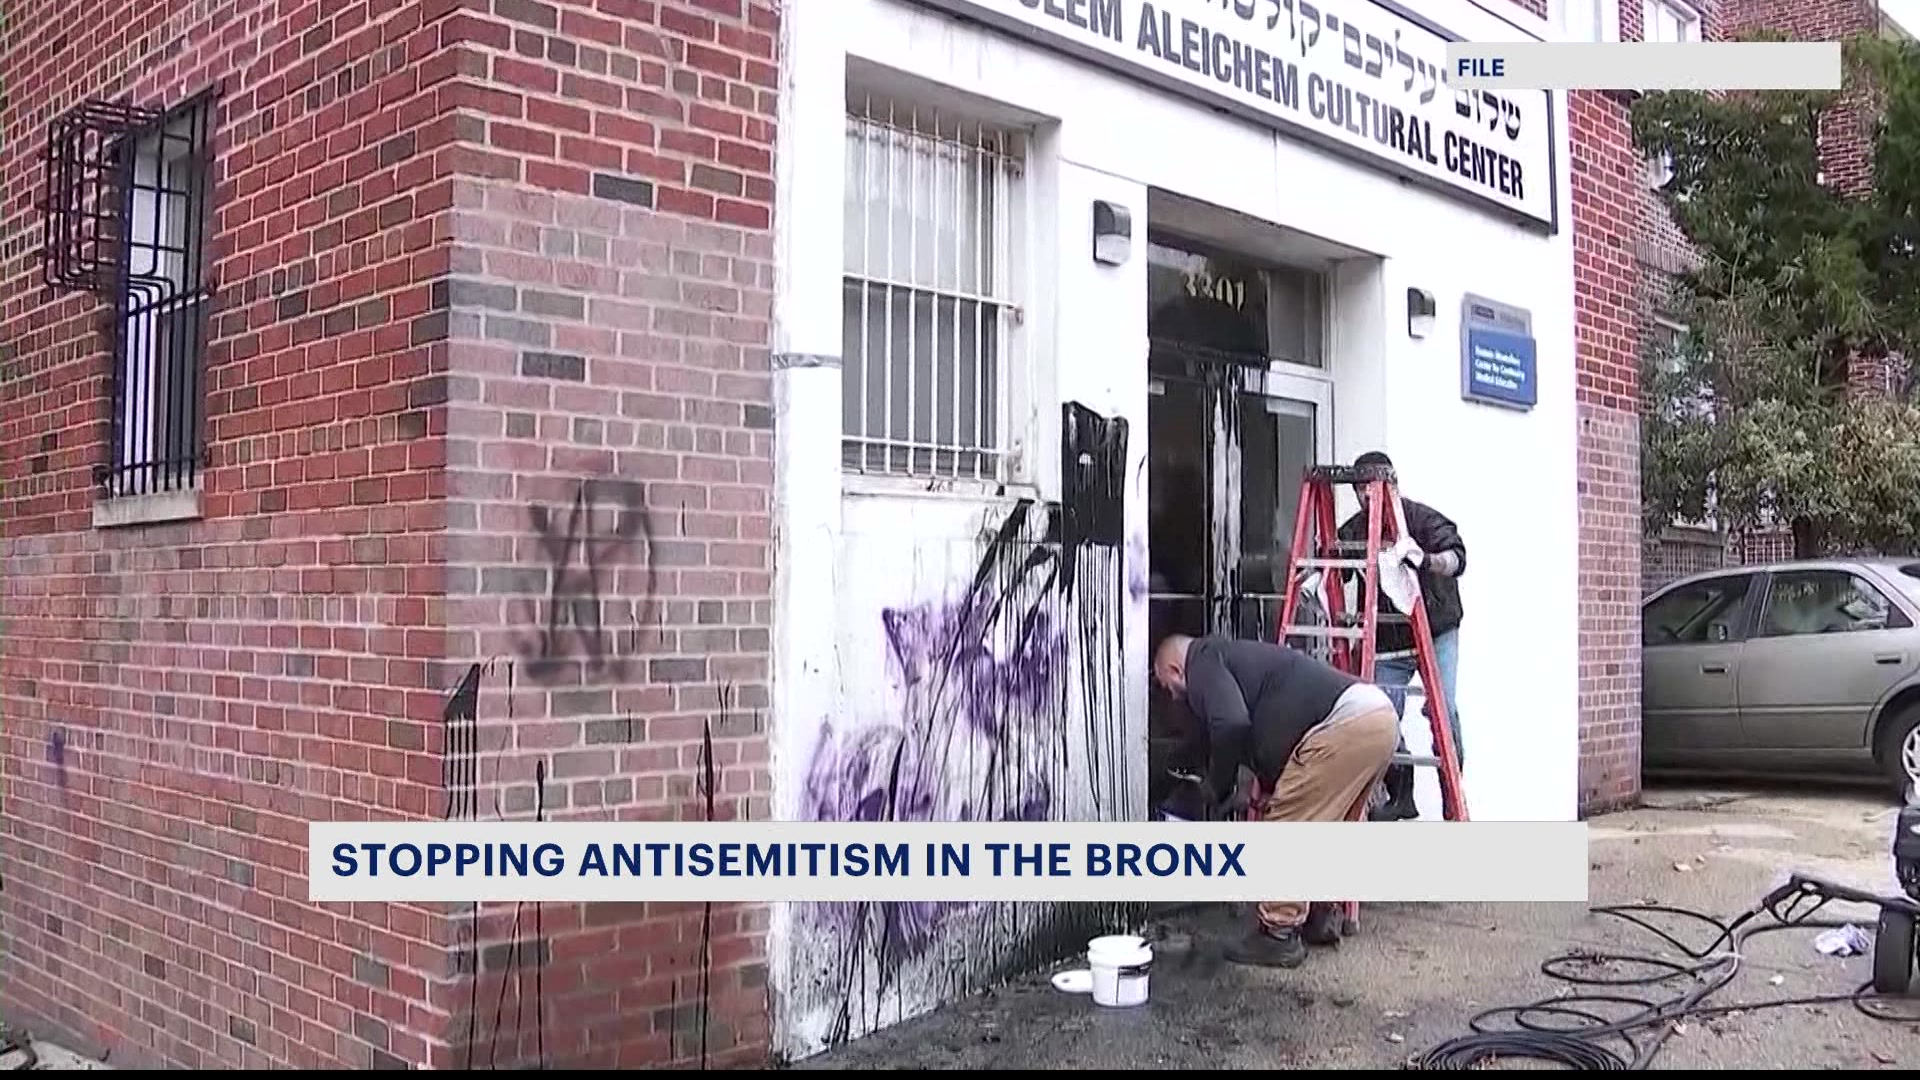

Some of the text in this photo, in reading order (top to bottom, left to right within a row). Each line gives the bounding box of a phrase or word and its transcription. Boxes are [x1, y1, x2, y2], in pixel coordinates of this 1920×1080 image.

[1136, 1, 1299, 111] ALEICHEM
[1307, 72, 1438, 165] CULTURAL
[1443, 130, 1524, 200] CENTER
